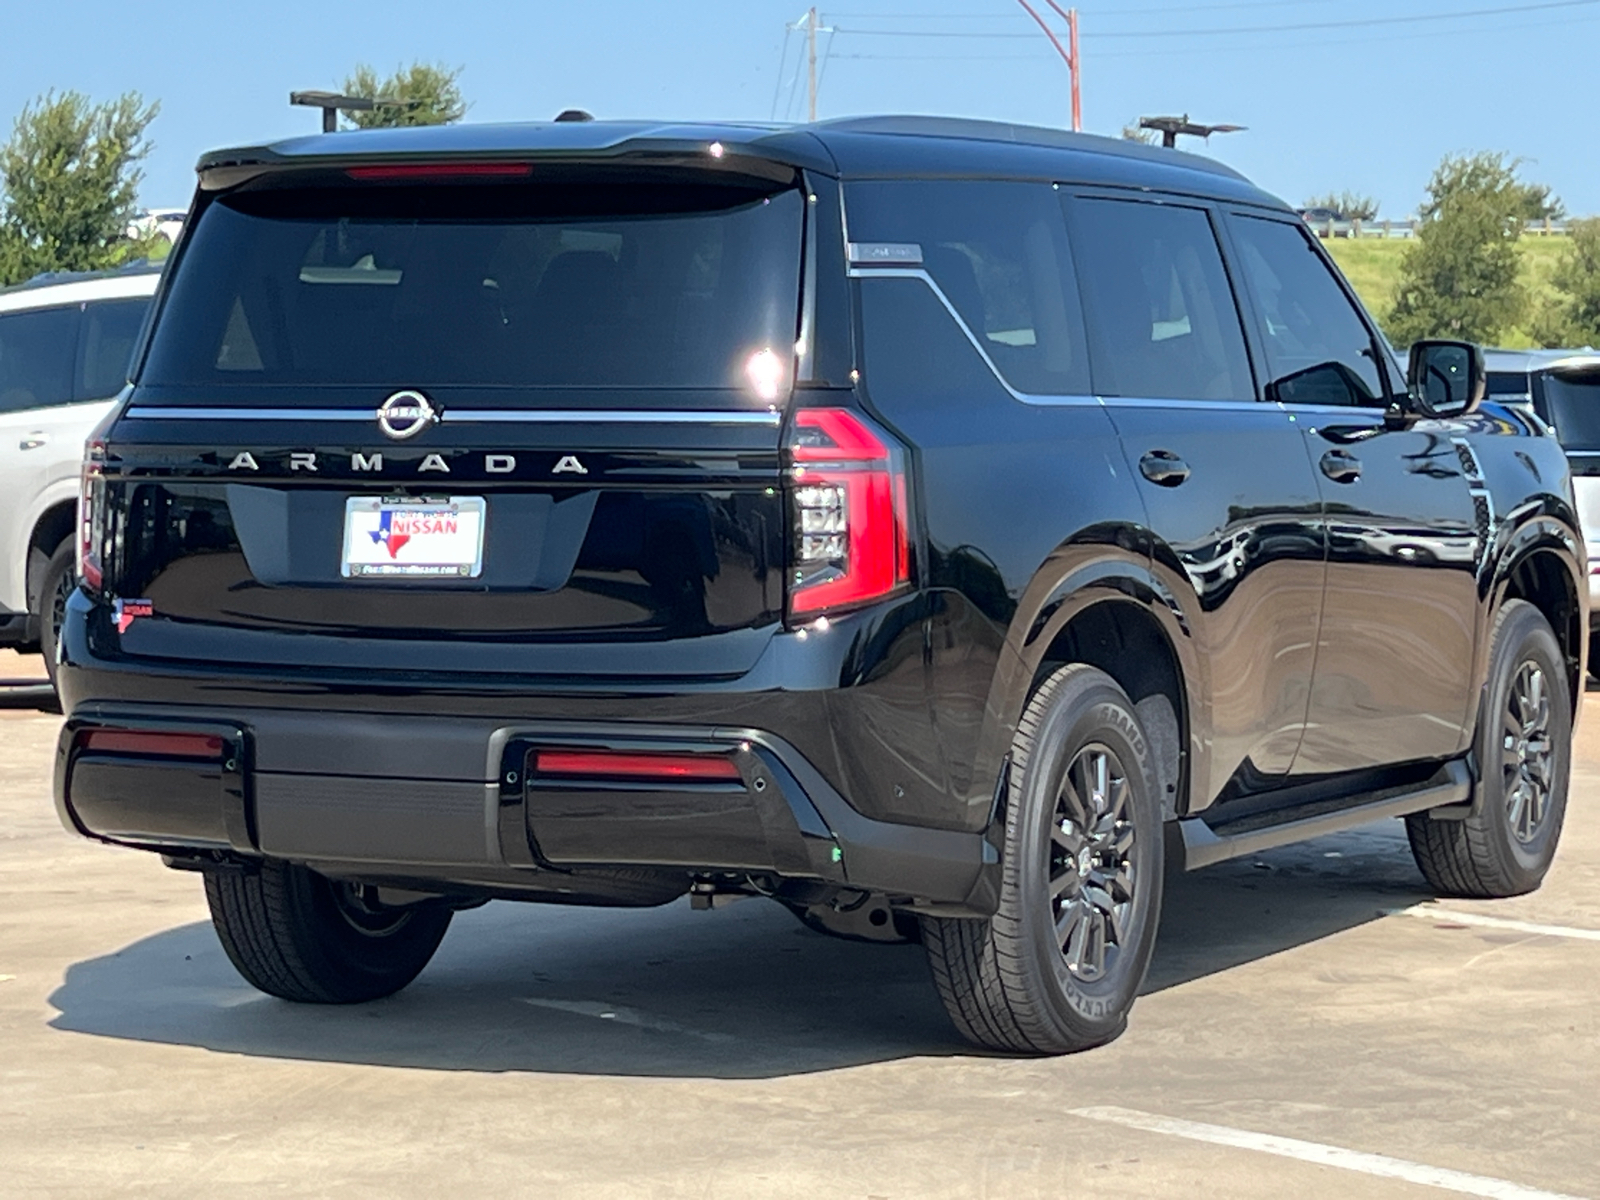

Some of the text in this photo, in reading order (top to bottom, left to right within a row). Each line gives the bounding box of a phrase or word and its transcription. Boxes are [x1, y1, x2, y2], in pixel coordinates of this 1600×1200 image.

[376, 407, 435, 420] NISSAN
[228, 451, 589, 475] ARMADA
[393, 520, 459, 535] NISSAN
